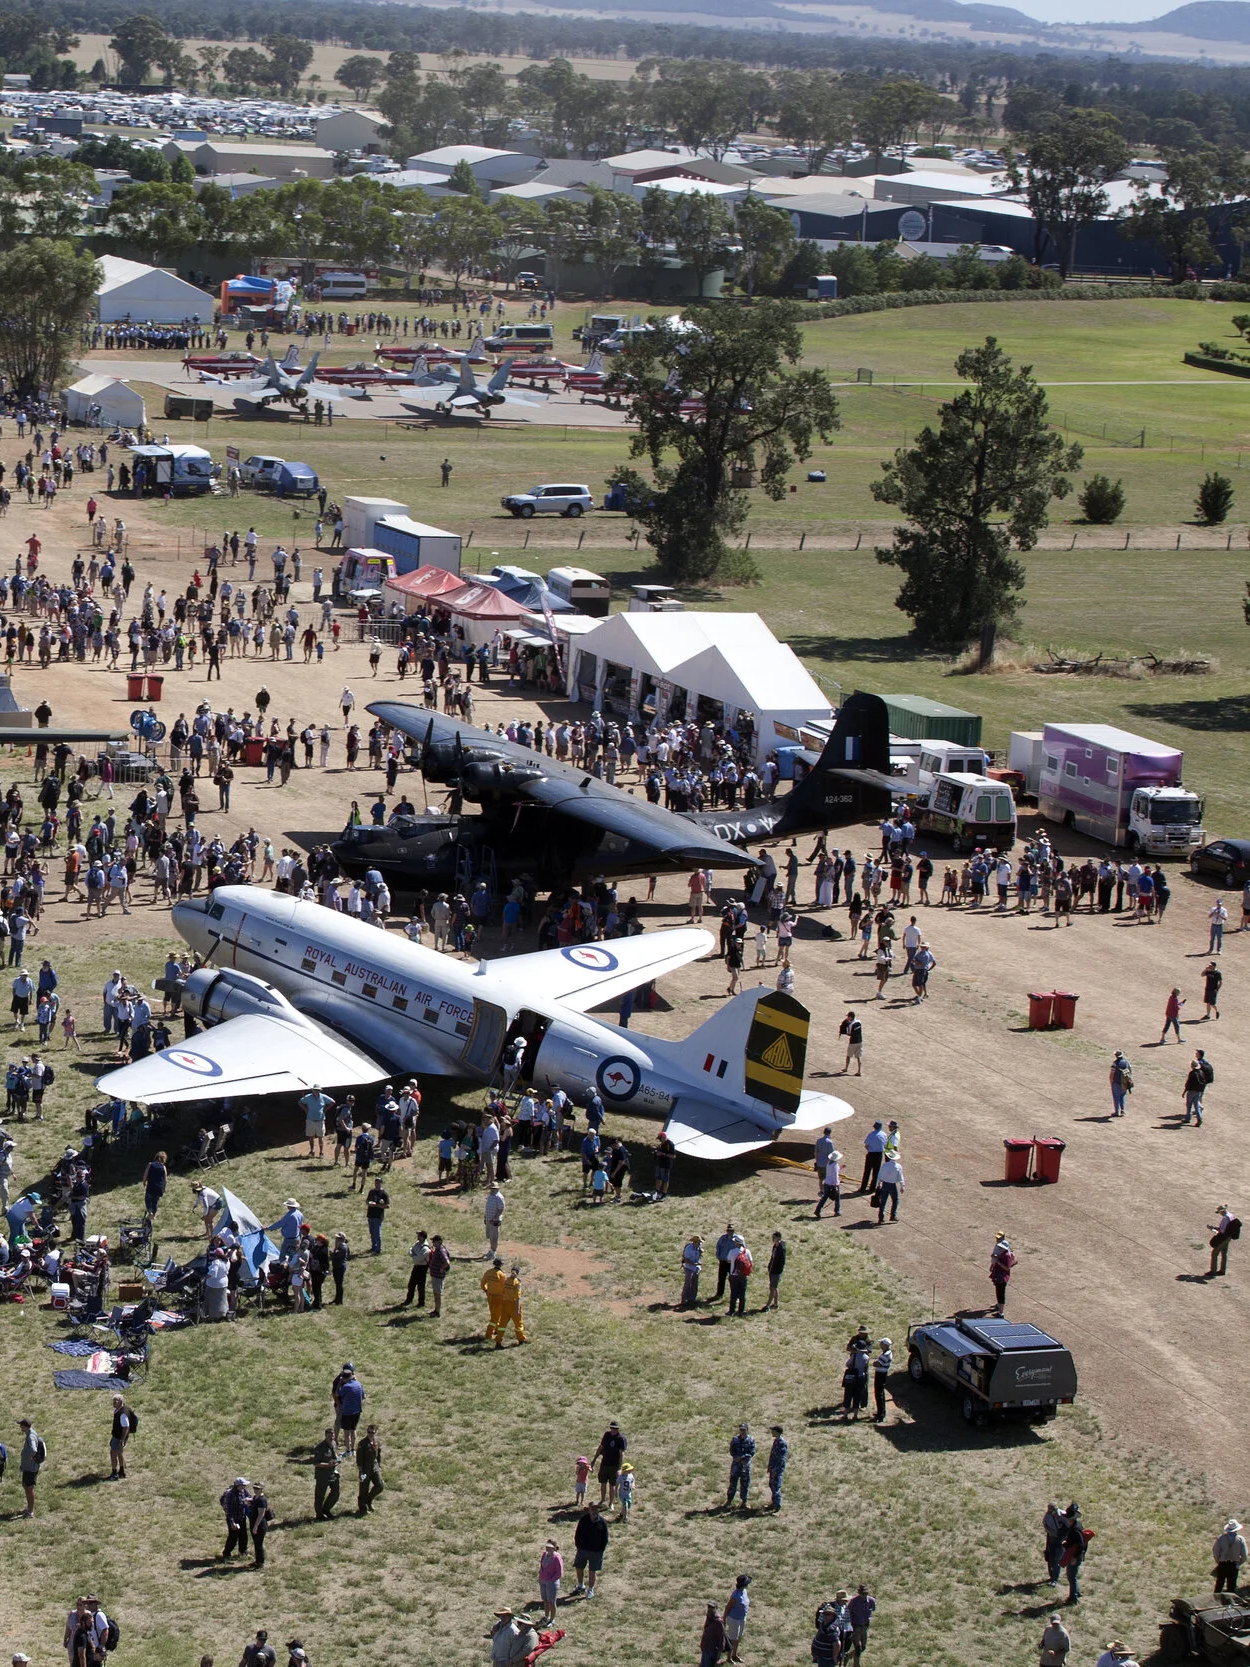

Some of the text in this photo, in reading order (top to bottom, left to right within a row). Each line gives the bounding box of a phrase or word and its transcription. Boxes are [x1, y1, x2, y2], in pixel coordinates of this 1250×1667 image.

[824, 794, 853, 804] A24-362
[304, 945, 474, 1024] ROYAL AUSTRALIAN AIR FORCE
[638, 1084, 670, 1101] A65-94
